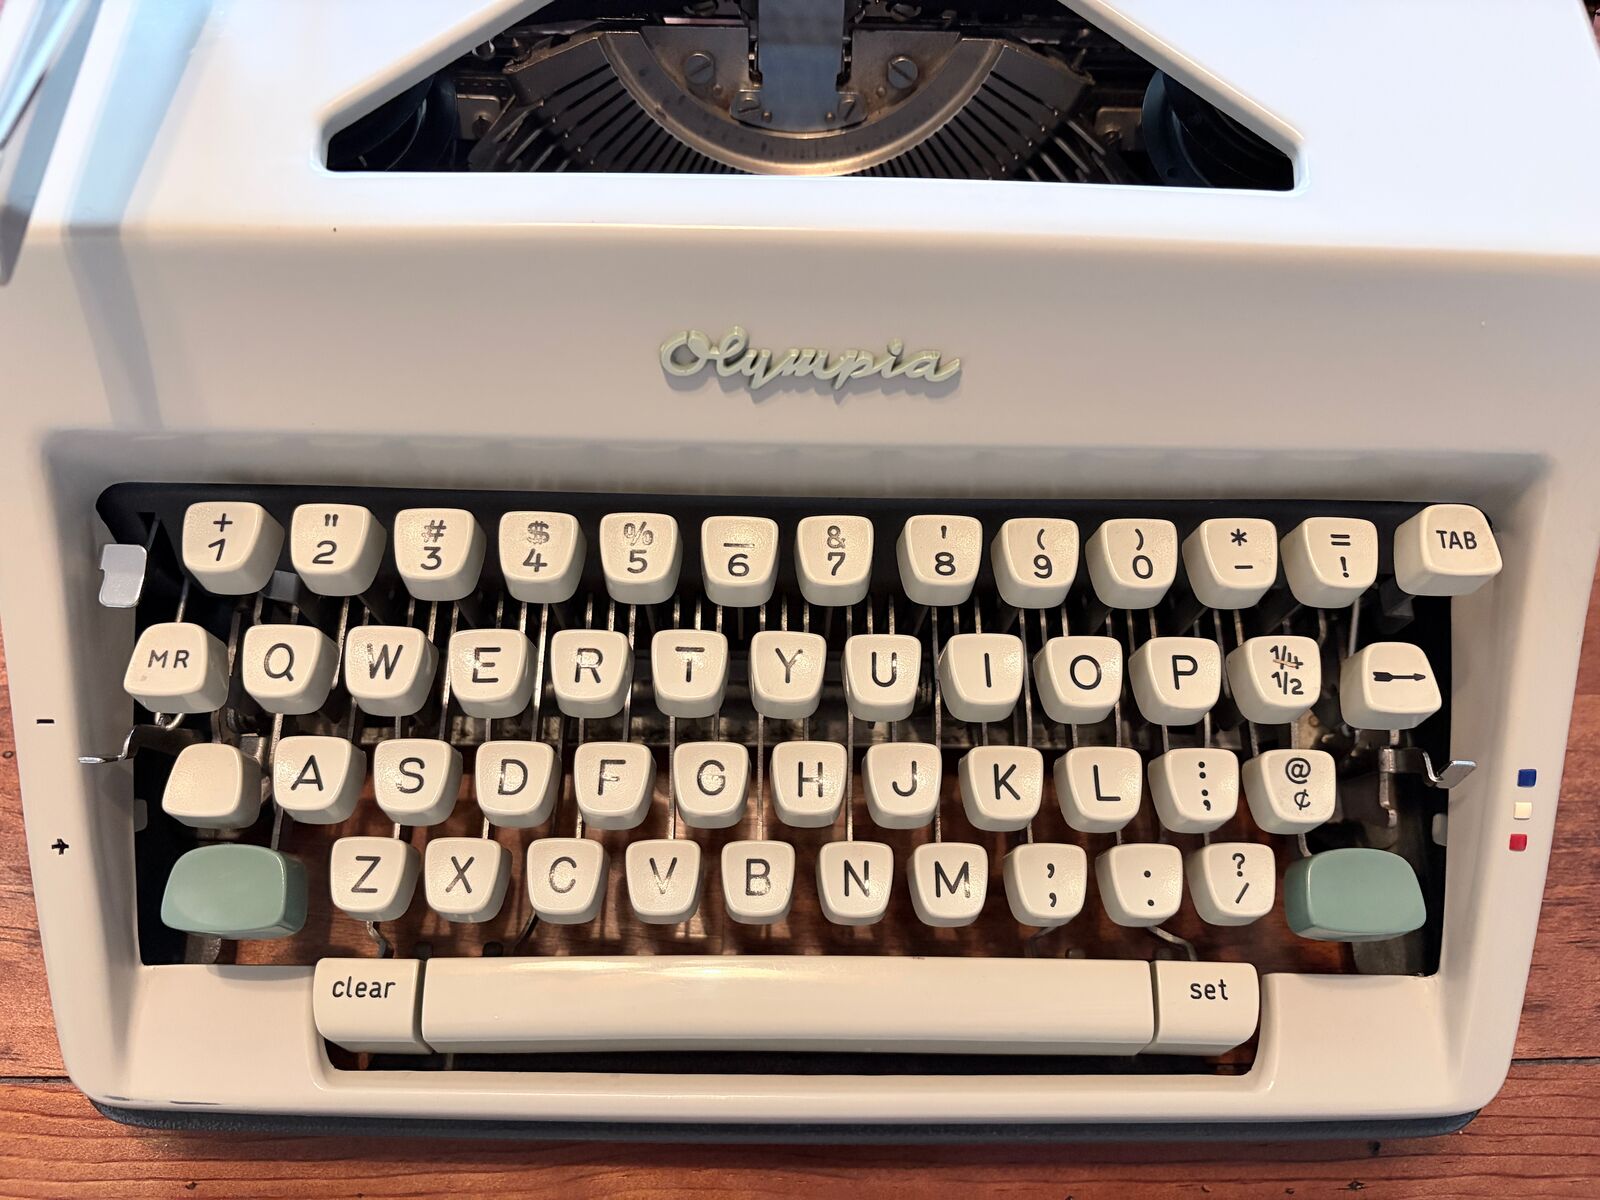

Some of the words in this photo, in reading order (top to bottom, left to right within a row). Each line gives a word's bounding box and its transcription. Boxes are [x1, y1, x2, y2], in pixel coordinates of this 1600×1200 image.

[659, 325, 961, 390] Olympia
[207, 538, 226, 562] 1
[312, 540, 338, 565] 2
[1435, 529, 1478, 550] TAB
[420, 546, 442, 571] 3
[522, 548, 548, 573] 4
[626, 549, 648, 574] 5
[727, 553, 750, 577] 6
[827, 551, 846, 577] 7
[934, 551, 956, 577] 8
[1033, 554, 1053, 579] 9
[1132, 554, 1154, 580] 0
[147, 649, 190, 669] MR
[263, 642, 295, 682] Q
[366, 643, 404, 680] W
[471, 646, 502, 684] E
[574, 647, 604, 684] R
[674, 646, 706, 683] T
[774, 647, 804, 684] Y
[871, 651, 897, 688] U
[1069, 654, 1102, 691] O
[1171, 654, 1199, 691] P
[290, 754, 324, 792] A
[397, 757, 426, 794] S
[497, 758, 529, 796] D
[597, 758, 627, 796] F
[696, 759, 726, 796] G
[797, 761, 824, 798] H
[891, 760, 918, 798] J
[993, 763, 1021, 801] K
[1092, 764, 1122, 802] L
[350, 855, 382, 894] Z
[445, 855, 475, 894] X
[548, 856, 577, 894] C
[648, 856, 678, 895] V
[745, 858, 771, 896] B
[843, 859, 870, 897] N
[934, 860, 970, 899] M
[332, 975, 396, 999] clear
[1190, 978, 1229, 1001] set
